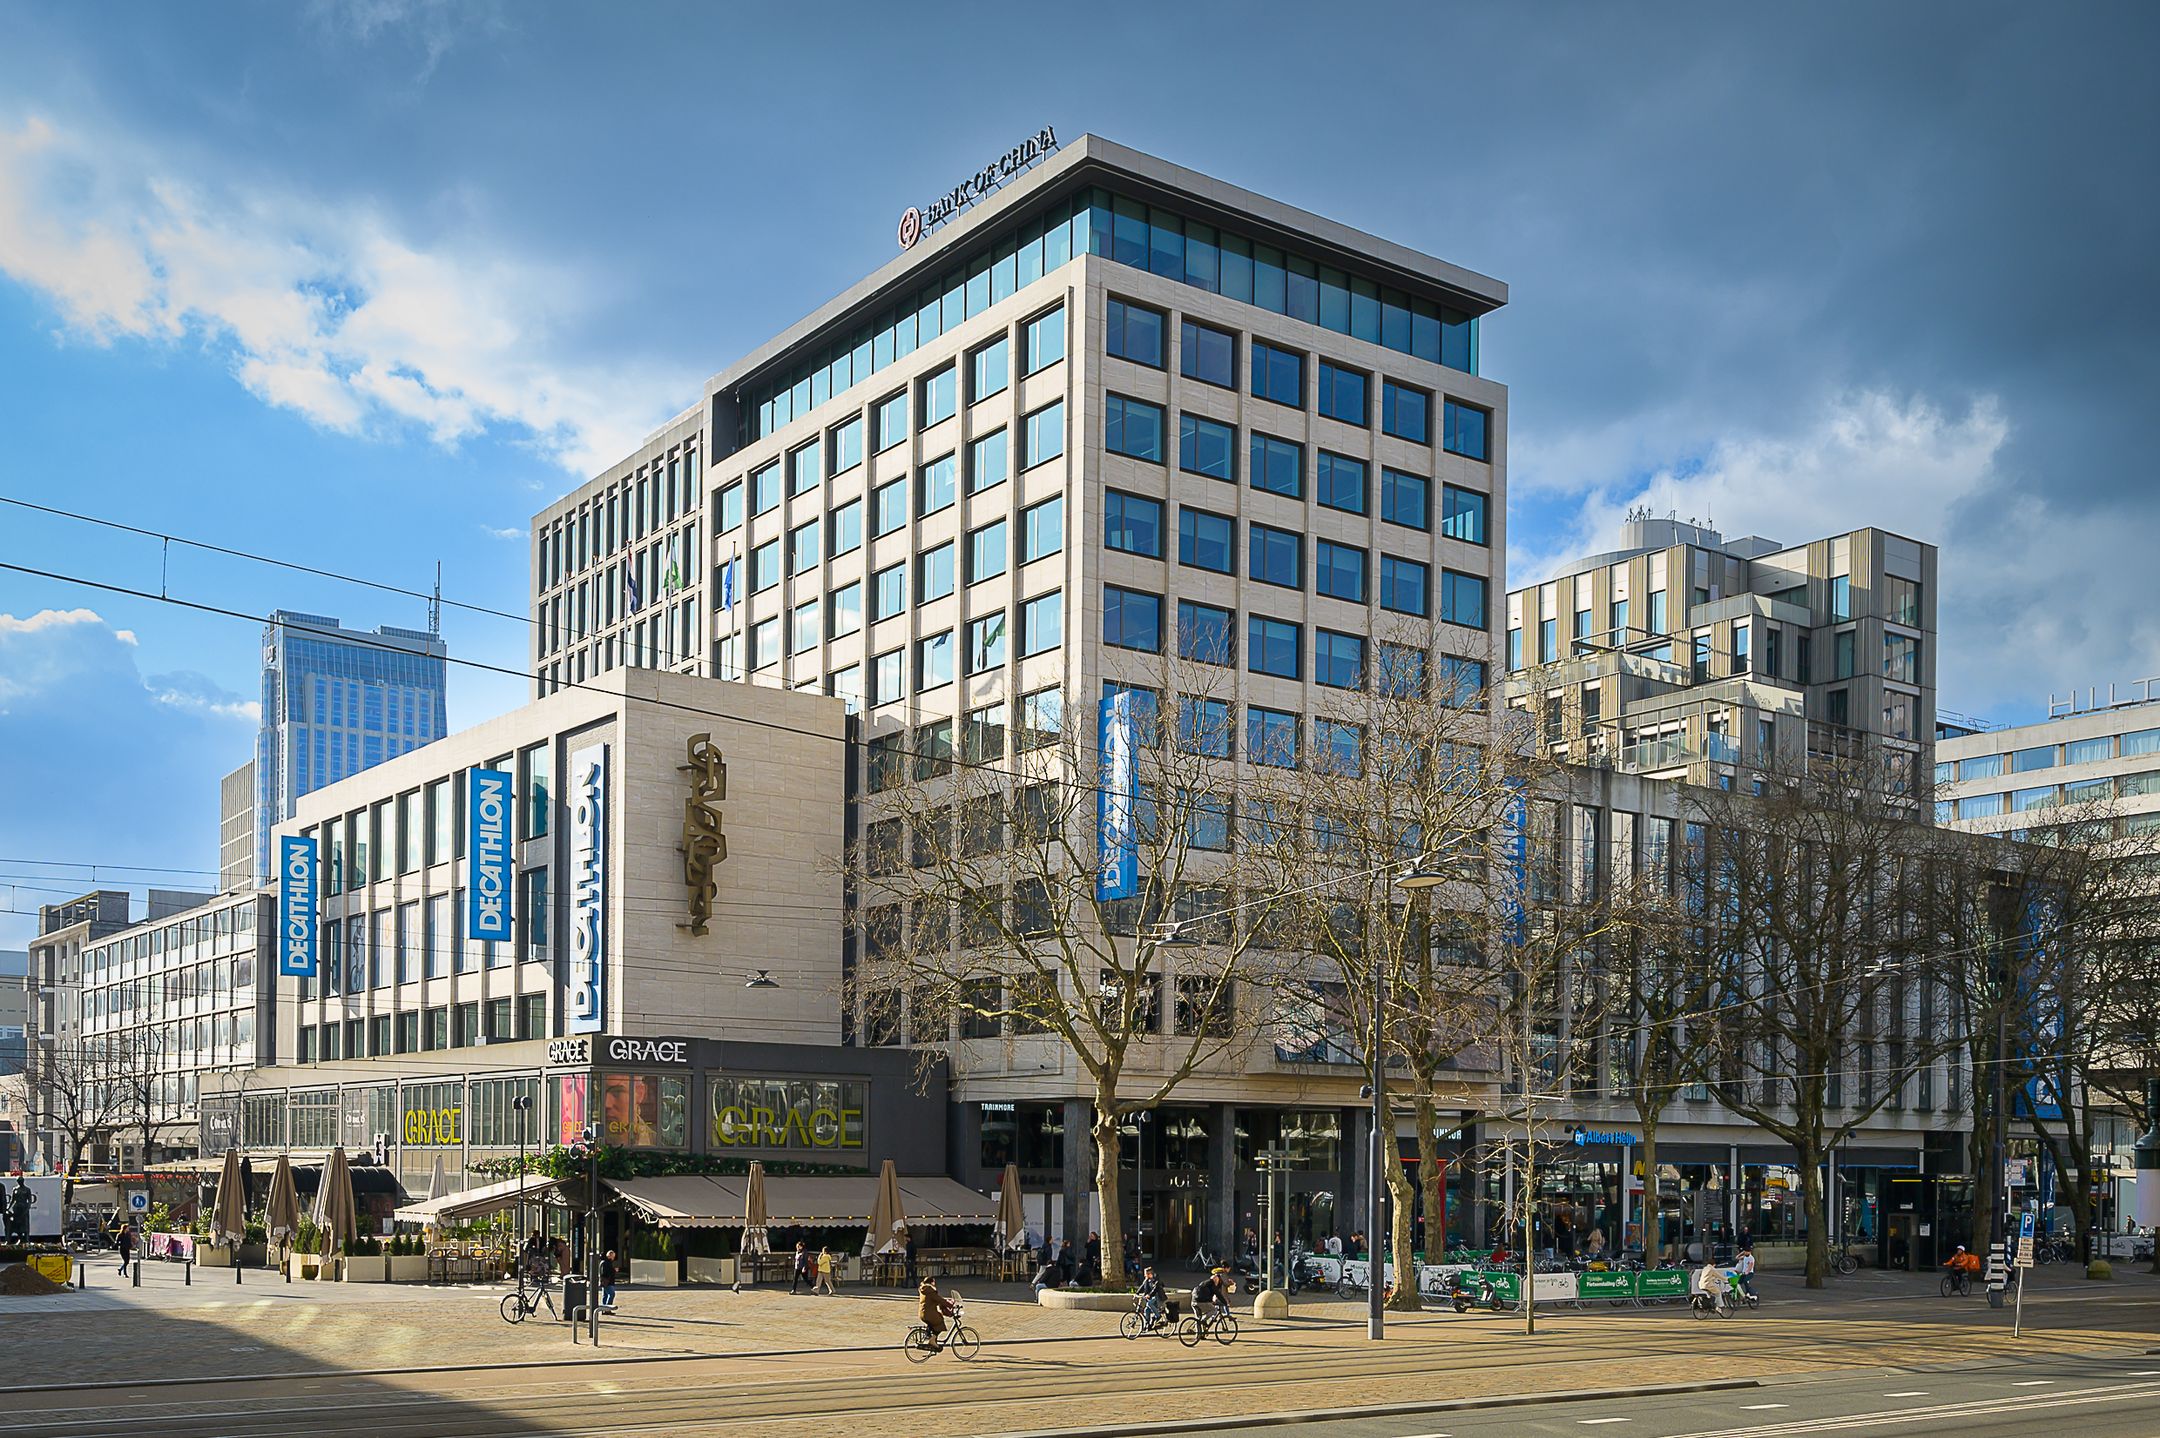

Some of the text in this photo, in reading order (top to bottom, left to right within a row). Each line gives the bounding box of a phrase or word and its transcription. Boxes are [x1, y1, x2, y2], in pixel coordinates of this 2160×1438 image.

[921, 180, 972, 226] BANK
[999, 125, 1058, 177] CHINA
[479, 779, 503, 931] DECATHLON
[288, 844, 309, 969] DECATHLON
[573, 761, 599, 1018] DECATHLON
[548, 1040, 584, 1062] GRACE
[609, 1039, 687, 1062] GRACE
[981, 1103, 1015, 1111] TRAINMORE
[405, 1108, 461, 1144] GRACE
[716, 1105, 862, 1146] GRACE
[1586, 1131, 1614, 1144] Albert
[1614, 1132, 1637, 1146] Heijn
[2025, 1216, 2033, 1228] P
